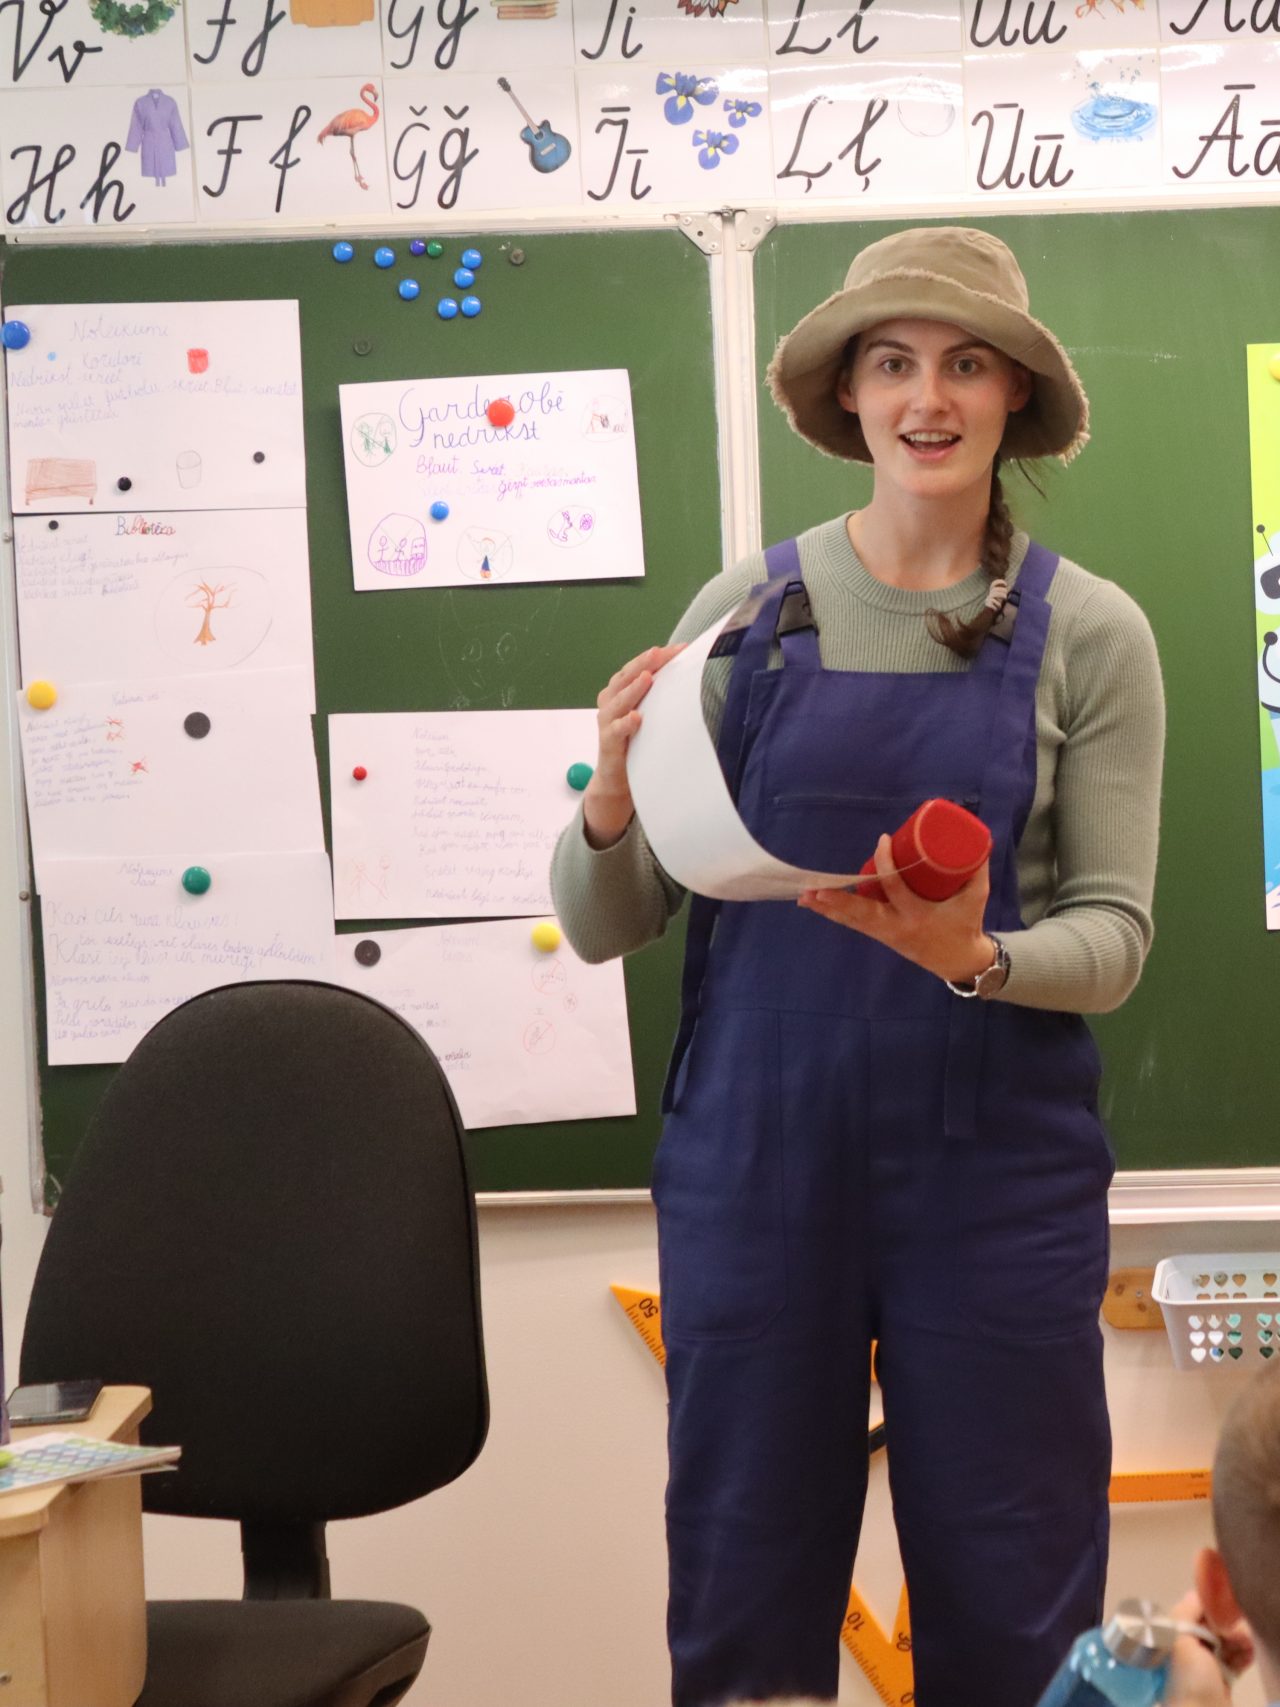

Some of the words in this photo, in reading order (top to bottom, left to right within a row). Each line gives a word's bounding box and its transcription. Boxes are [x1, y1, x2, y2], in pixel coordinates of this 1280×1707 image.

[5, 141, 136, 225] Hh
[399, 381, 566, 448] Gardeobē
[639, 1298, 659, 1319] 50
[846, 1612, 865, 1632] 10
